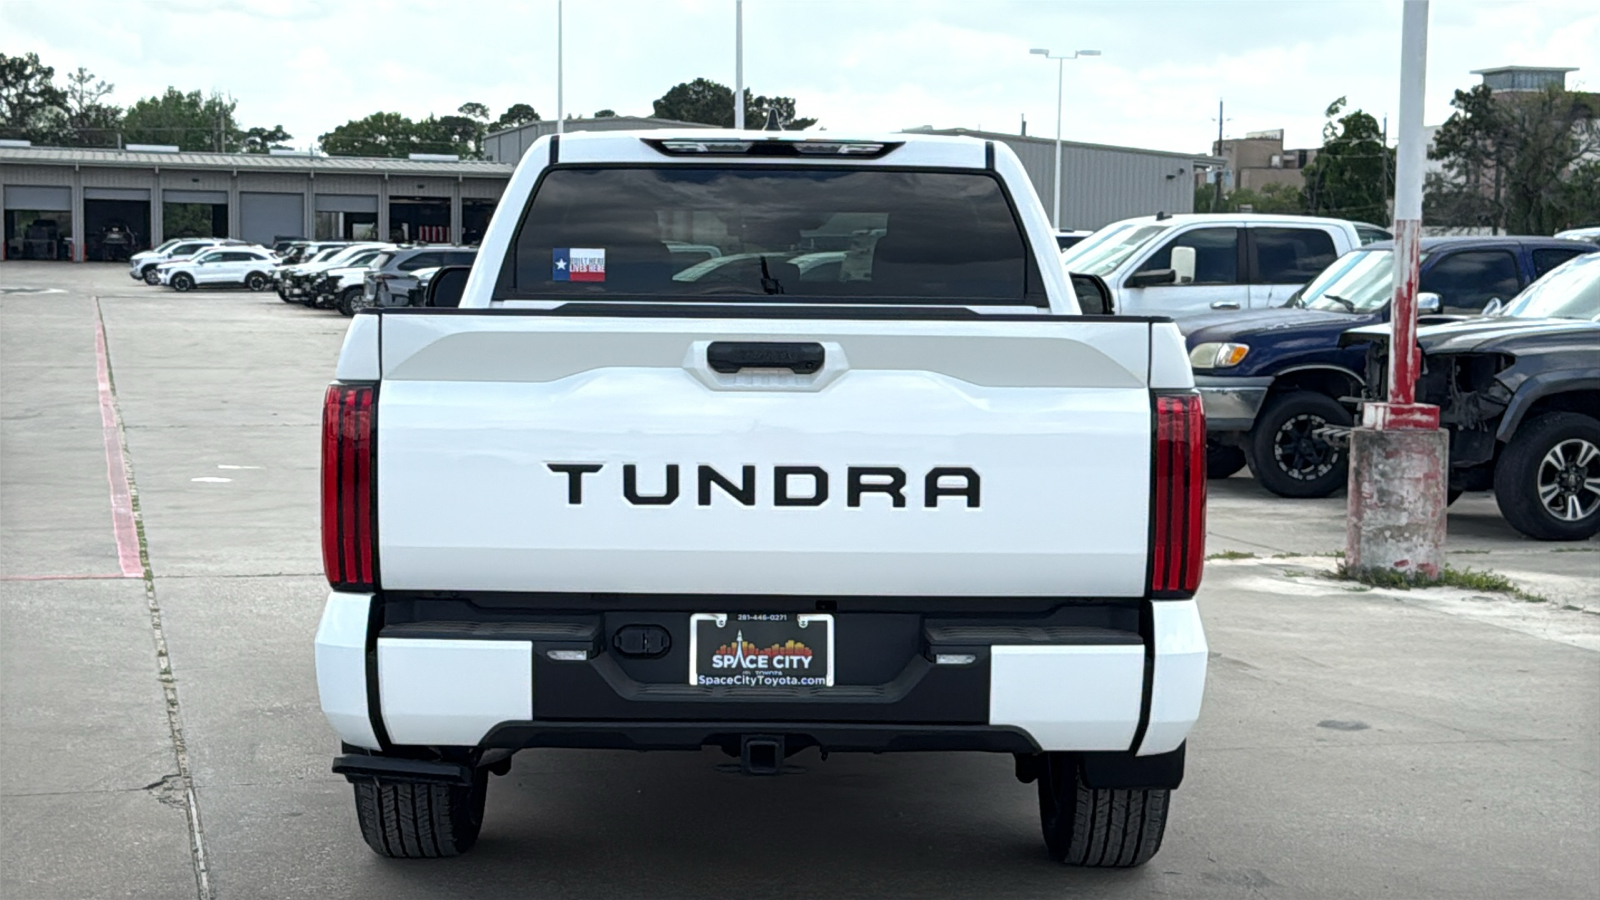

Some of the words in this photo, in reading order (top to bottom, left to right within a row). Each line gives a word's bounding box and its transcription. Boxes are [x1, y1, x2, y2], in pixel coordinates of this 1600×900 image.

[570, 264, 588, 273] LIVES
[589, 264, 605, 273] HERE
[546, 463, 981, 508] TUNDRA
[737, 613, 788, 621] 281-446-0271
[712, 654, 769, 669] SPACE
[773, 654, 813, 669] CITY
[698, 675, 827, 687] SpaceCityToyota.com
